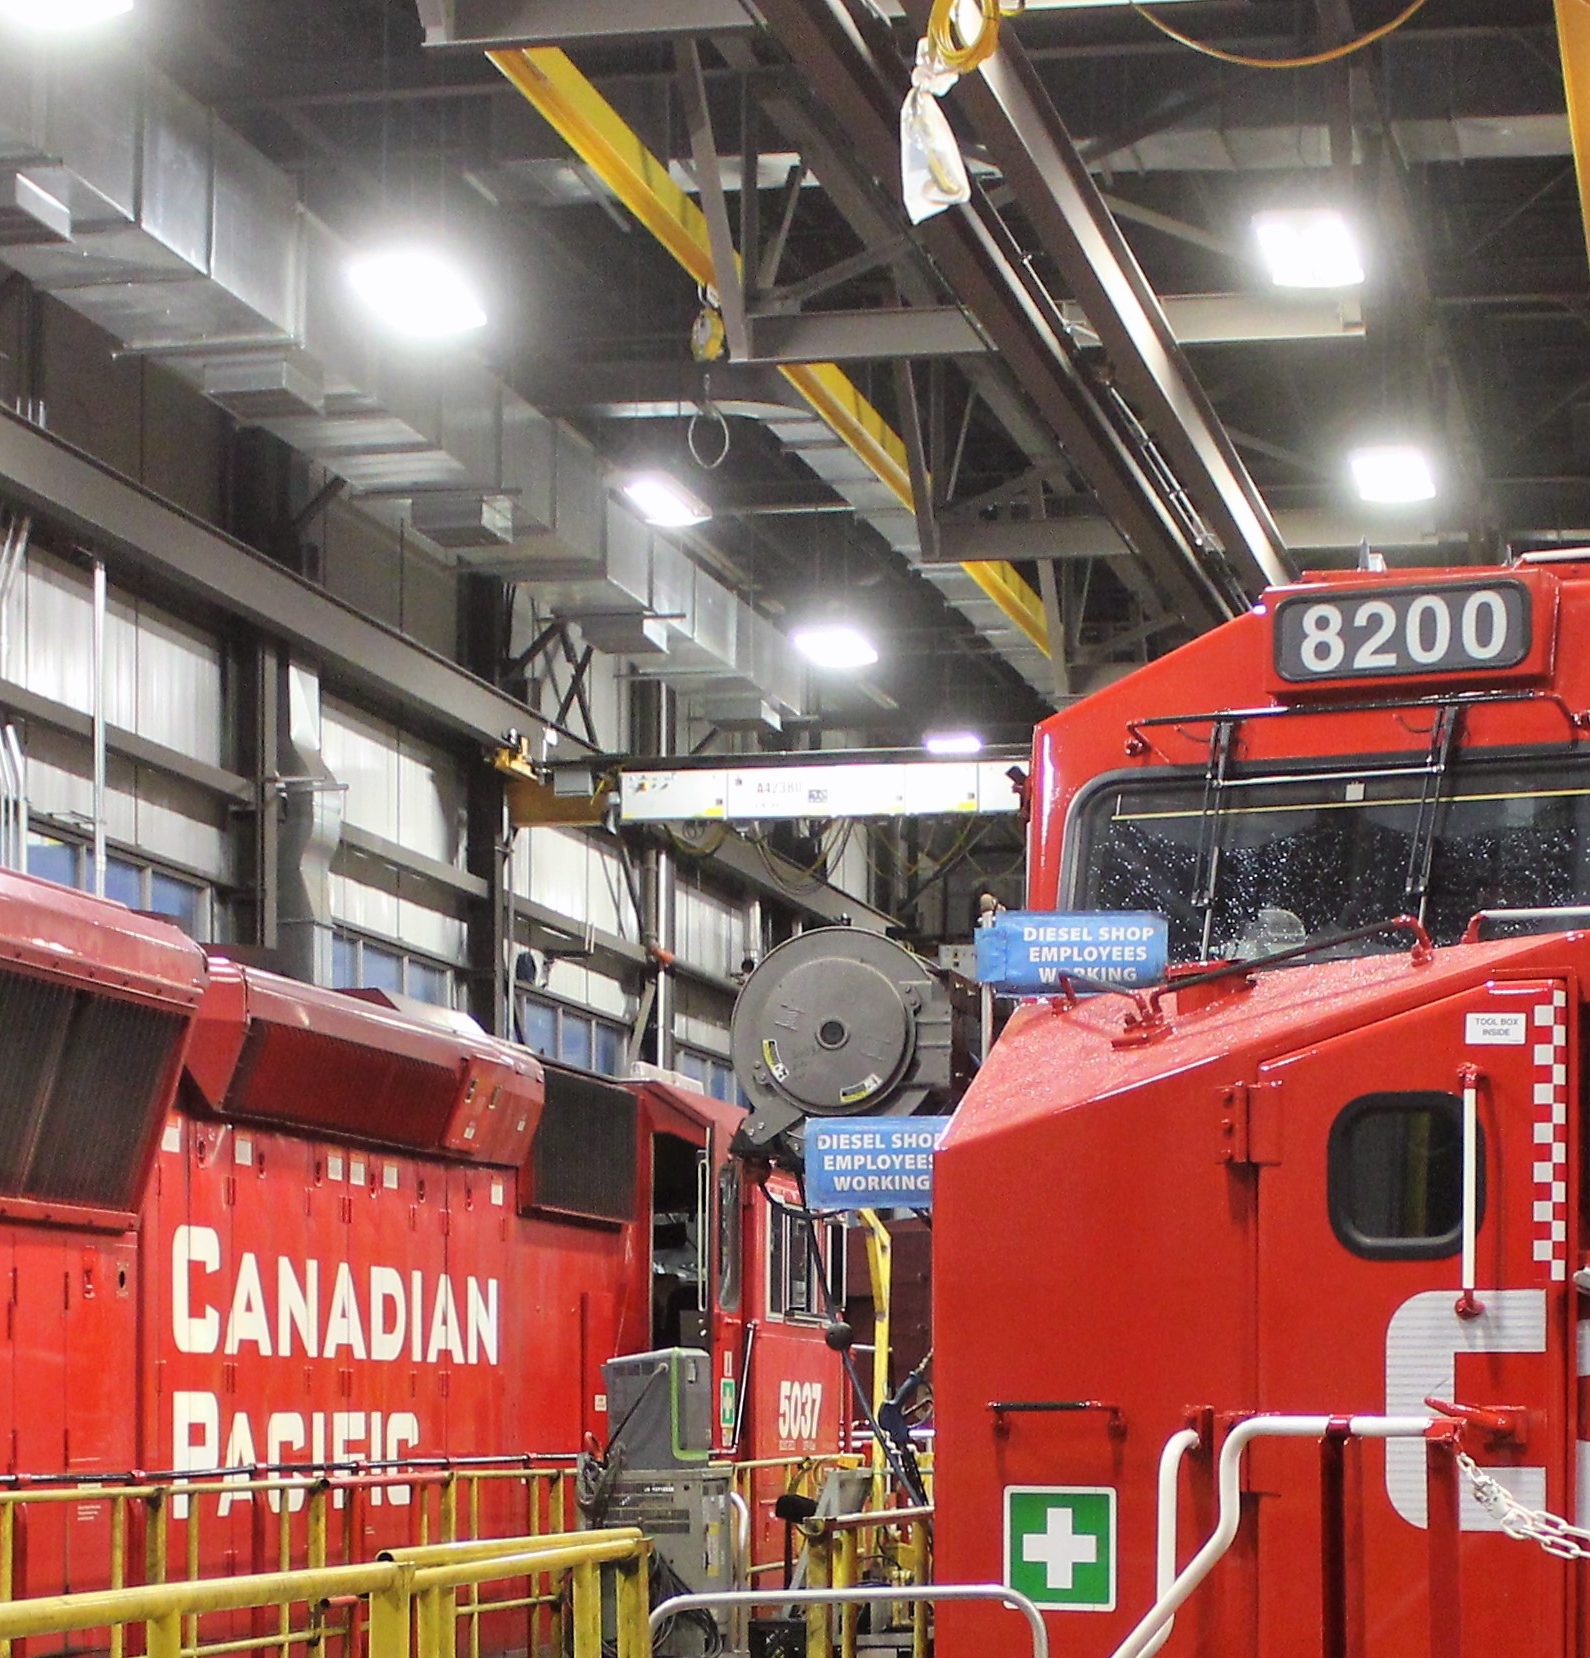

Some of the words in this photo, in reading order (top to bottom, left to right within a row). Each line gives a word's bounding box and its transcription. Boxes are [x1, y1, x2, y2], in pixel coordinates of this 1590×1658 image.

[1299, 589, 1508, 673] 8200
[1023, 927, 1093, 942] DIESEL
[1098, 926, 1155, 942] SHOP
[1029, 946, 1147, 962] EMPLOYEES
[1038, 967, 1137, 984] WRKING
[1475, 1017, 1497, 1026] TOOL
[1500, 1017, 1519, 1025] BOX
[1482, 1028, 1510, 1036] INSIDE
[817, 1133, 886, 1150] DIESEL
[833, 1175, 930, 1191] WORKING
[172, 1224, 498, 1366] CANADIAN
[778, 1380, 822, 1440] 5037
[172, 1390, 419, 1520] PACIFIC
